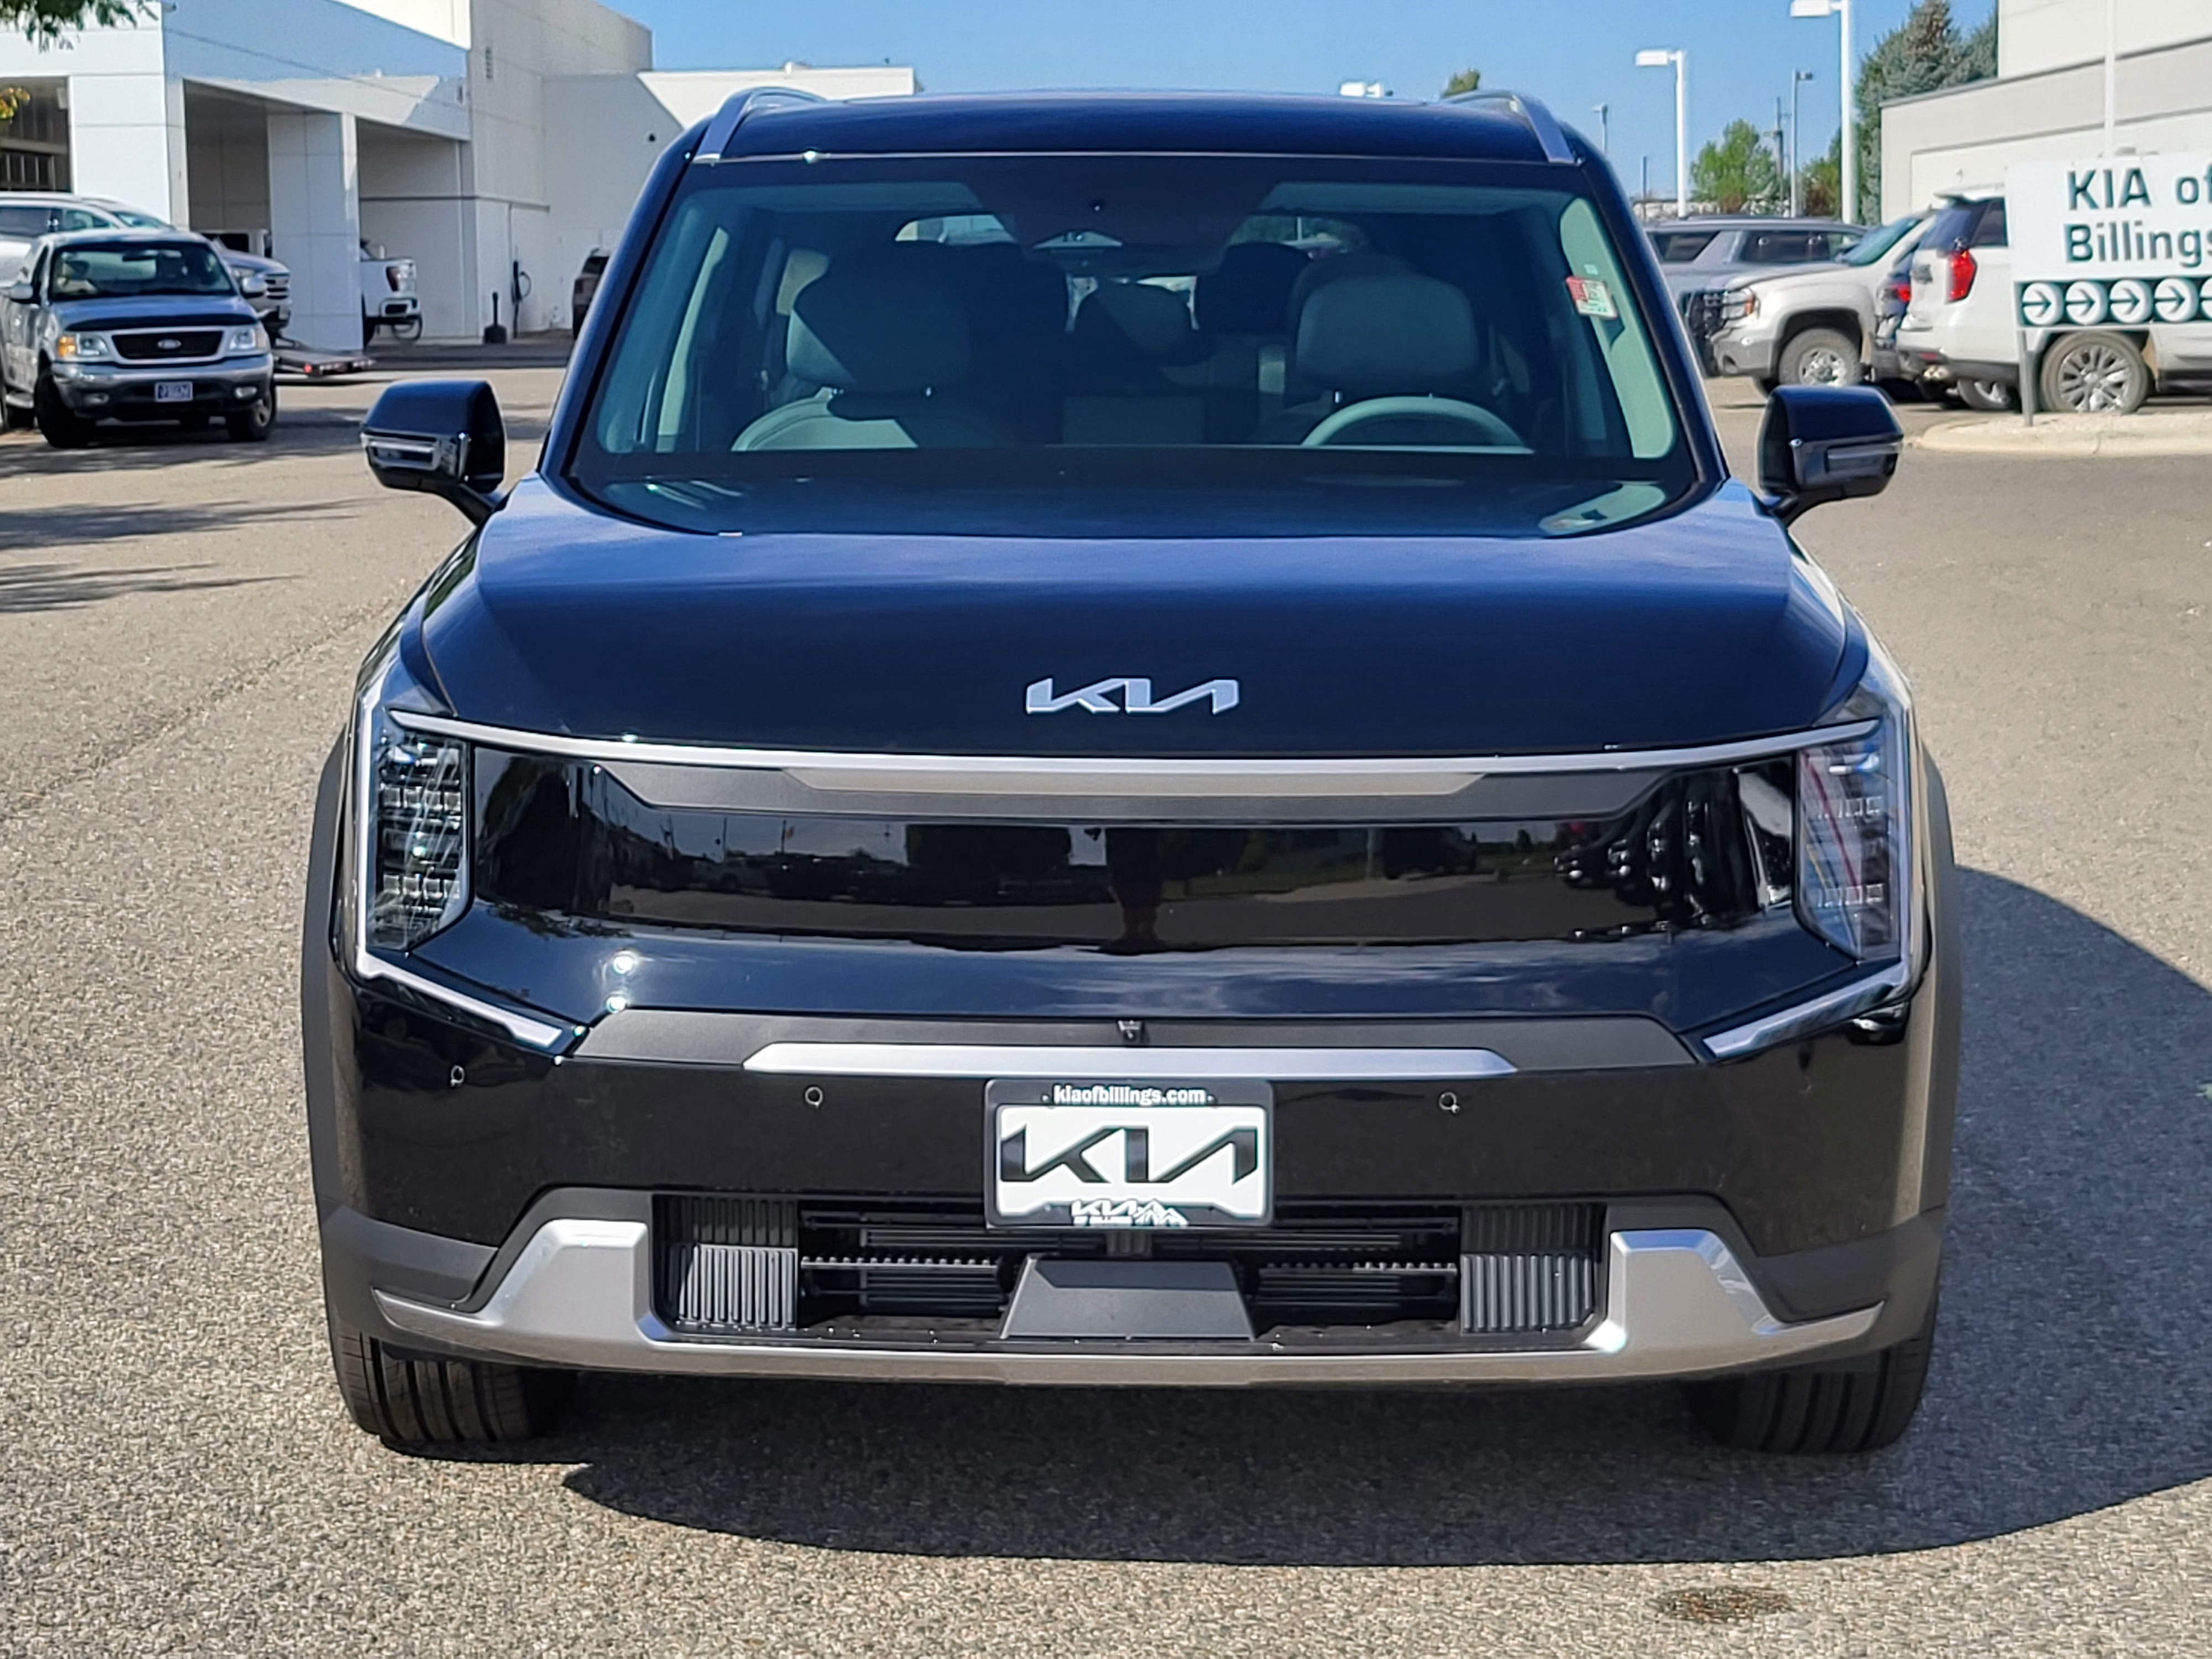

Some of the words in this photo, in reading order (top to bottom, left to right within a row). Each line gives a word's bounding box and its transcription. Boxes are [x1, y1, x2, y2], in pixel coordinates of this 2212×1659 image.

[2067, 167, 2152, 210] KIA
[2064, 220, 2212, 269] Billing
[1026, 677, 1240, 714] KIA
[1053, 1084, 1207, 1106] kiaofbillings.com
[1000, 1125, 1258, 1185] KIA
